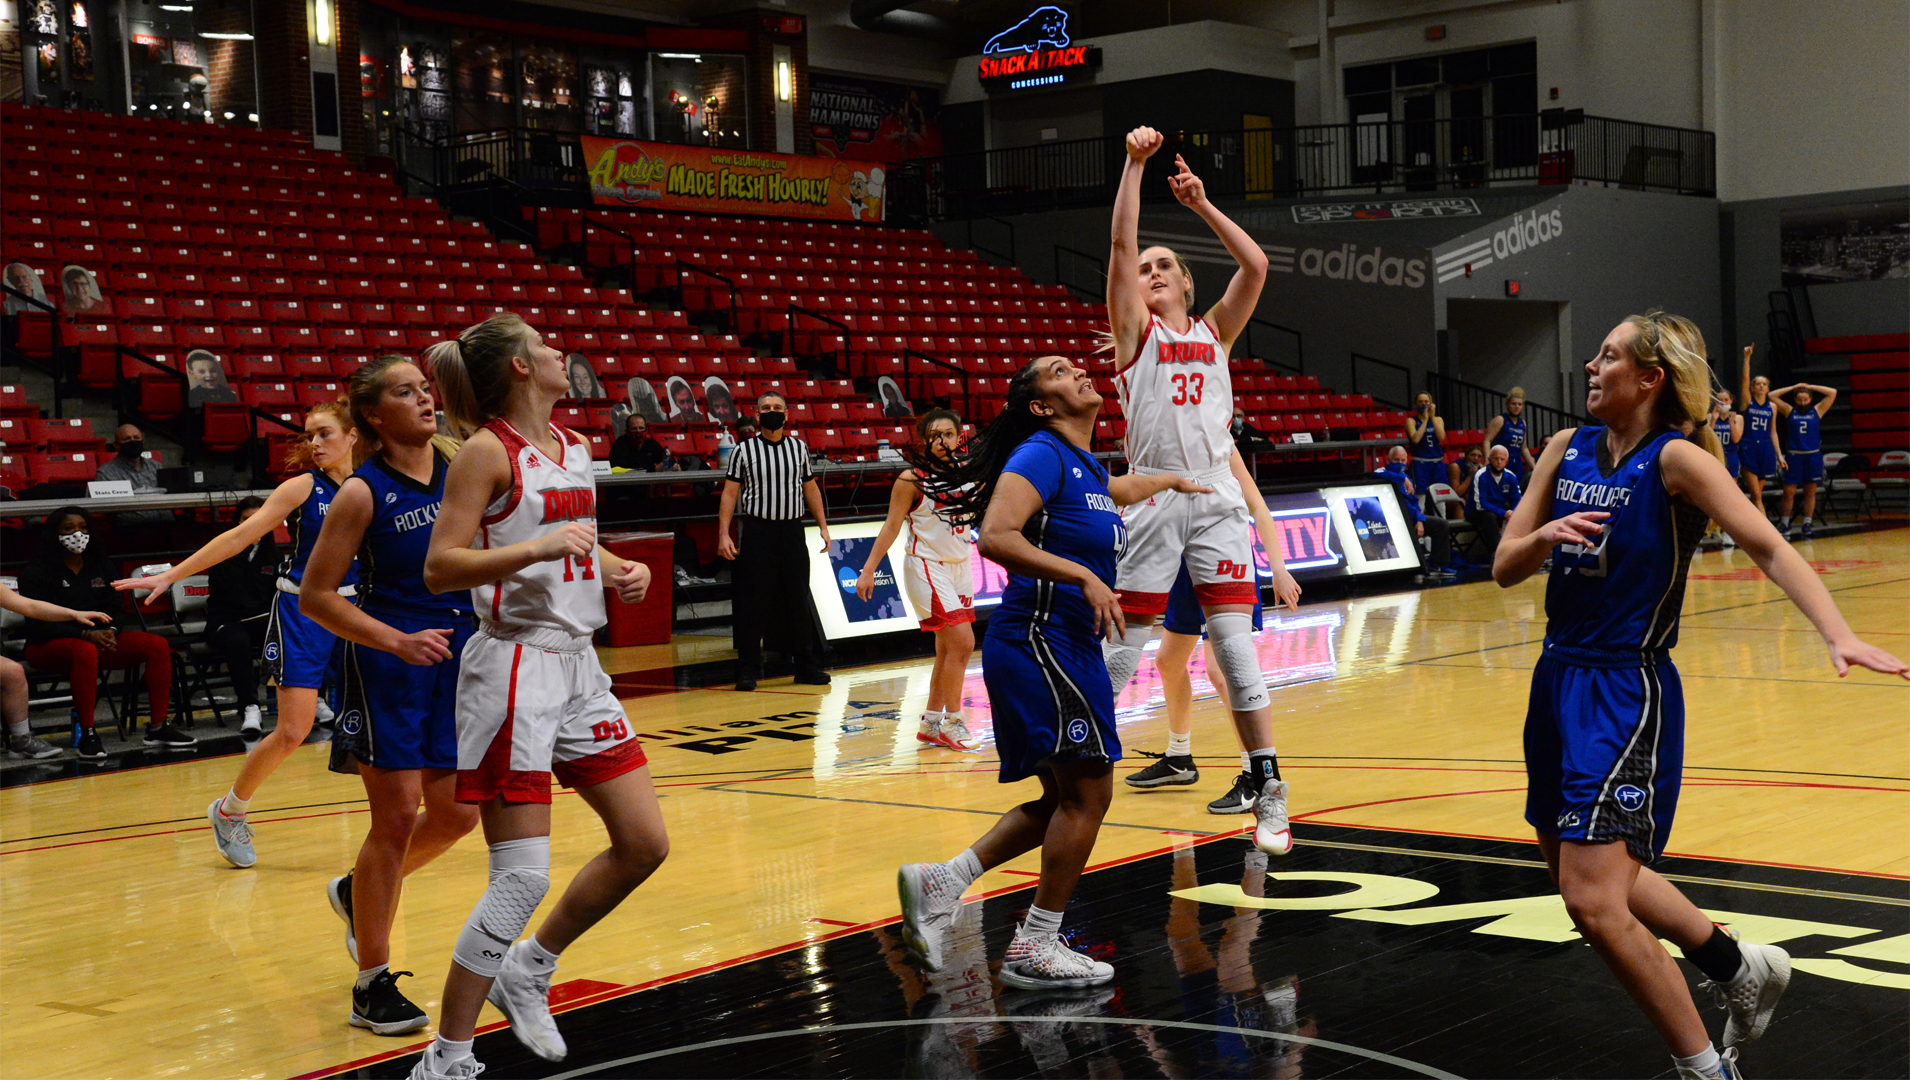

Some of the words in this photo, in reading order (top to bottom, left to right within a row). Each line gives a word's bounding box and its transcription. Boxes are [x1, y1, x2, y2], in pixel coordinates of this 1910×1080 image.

[1011, 74, 1065, 89] CONCESSIONS
[809, 91, 875, 112] NATIONAL
[808, 107, 880, 130] HAMPIONS
[587, 148, 667, 187] Andy's
[1493, 210, 1563, 260] adidas
[1300, 243, 1427, 288] adidas
[1171, 373, 1204, 406] 33
[1751, 417, 1768, 432] 24
[1799, 421, 1808, 434] 2
[1426, 434, 1434, 448] 5
[1510, 434, 1524, 448] 32
[540, 487, 597, 524] DRUR
[1217, 560, 1247, 580] DU
[184, 585, 210, 597] DRU
[842, 578, 858, 588] NCA
[874, 578, 890, 586] vision
[589, 717, 628, 744] DU
